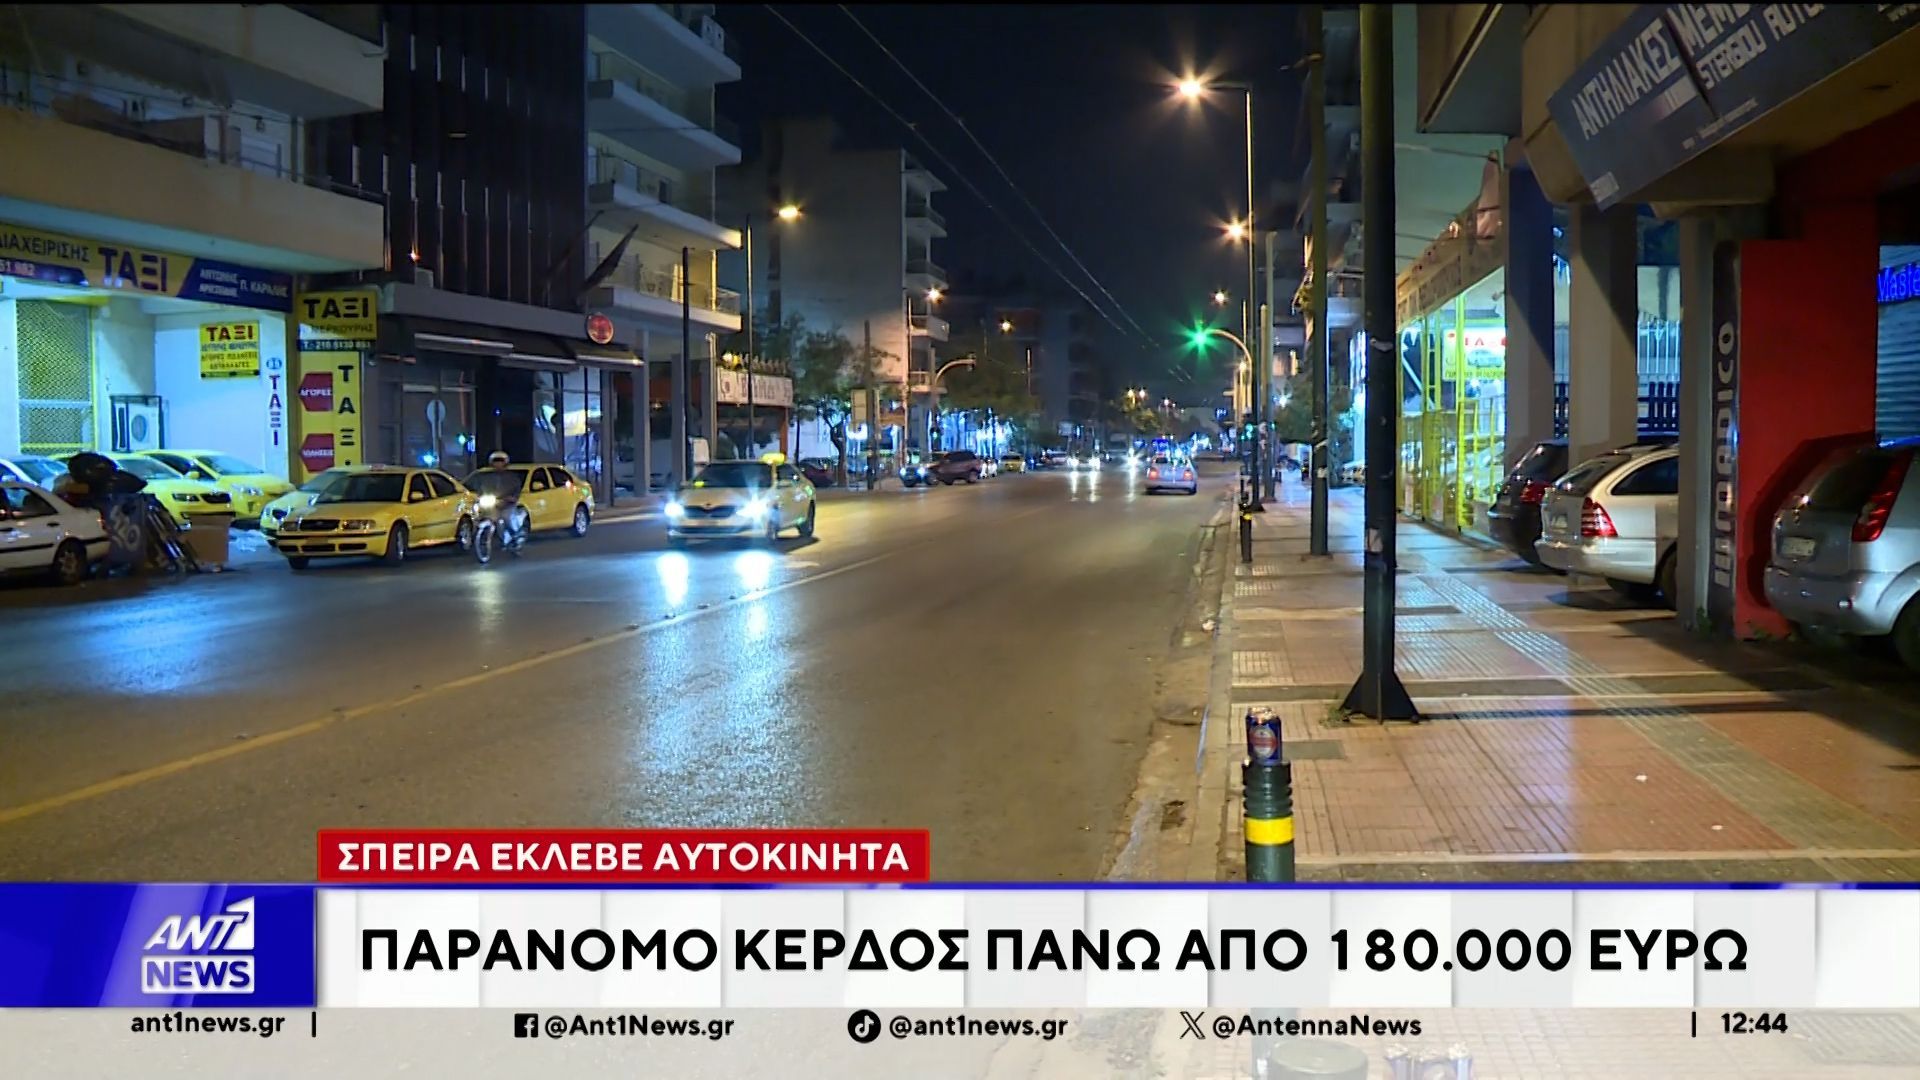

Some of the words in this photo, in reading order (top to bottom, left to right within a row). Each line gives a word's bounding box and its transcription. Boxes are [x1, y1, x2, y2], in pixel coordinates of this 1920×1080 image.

[1571, 17, 1682, 140] ΑΝΤΗΛΙΑΚΕΣ
[98, 247, 168, 292] ΤΑΞΙ
[206, 325, 253, 341] ΤΑΞΙ
[303, 297, 368, 319] ΤΑΞΙ
[269, 374, 282, 446] ΤΑΞΙ
[338, 365, 355, 466] ΤΑΞ
